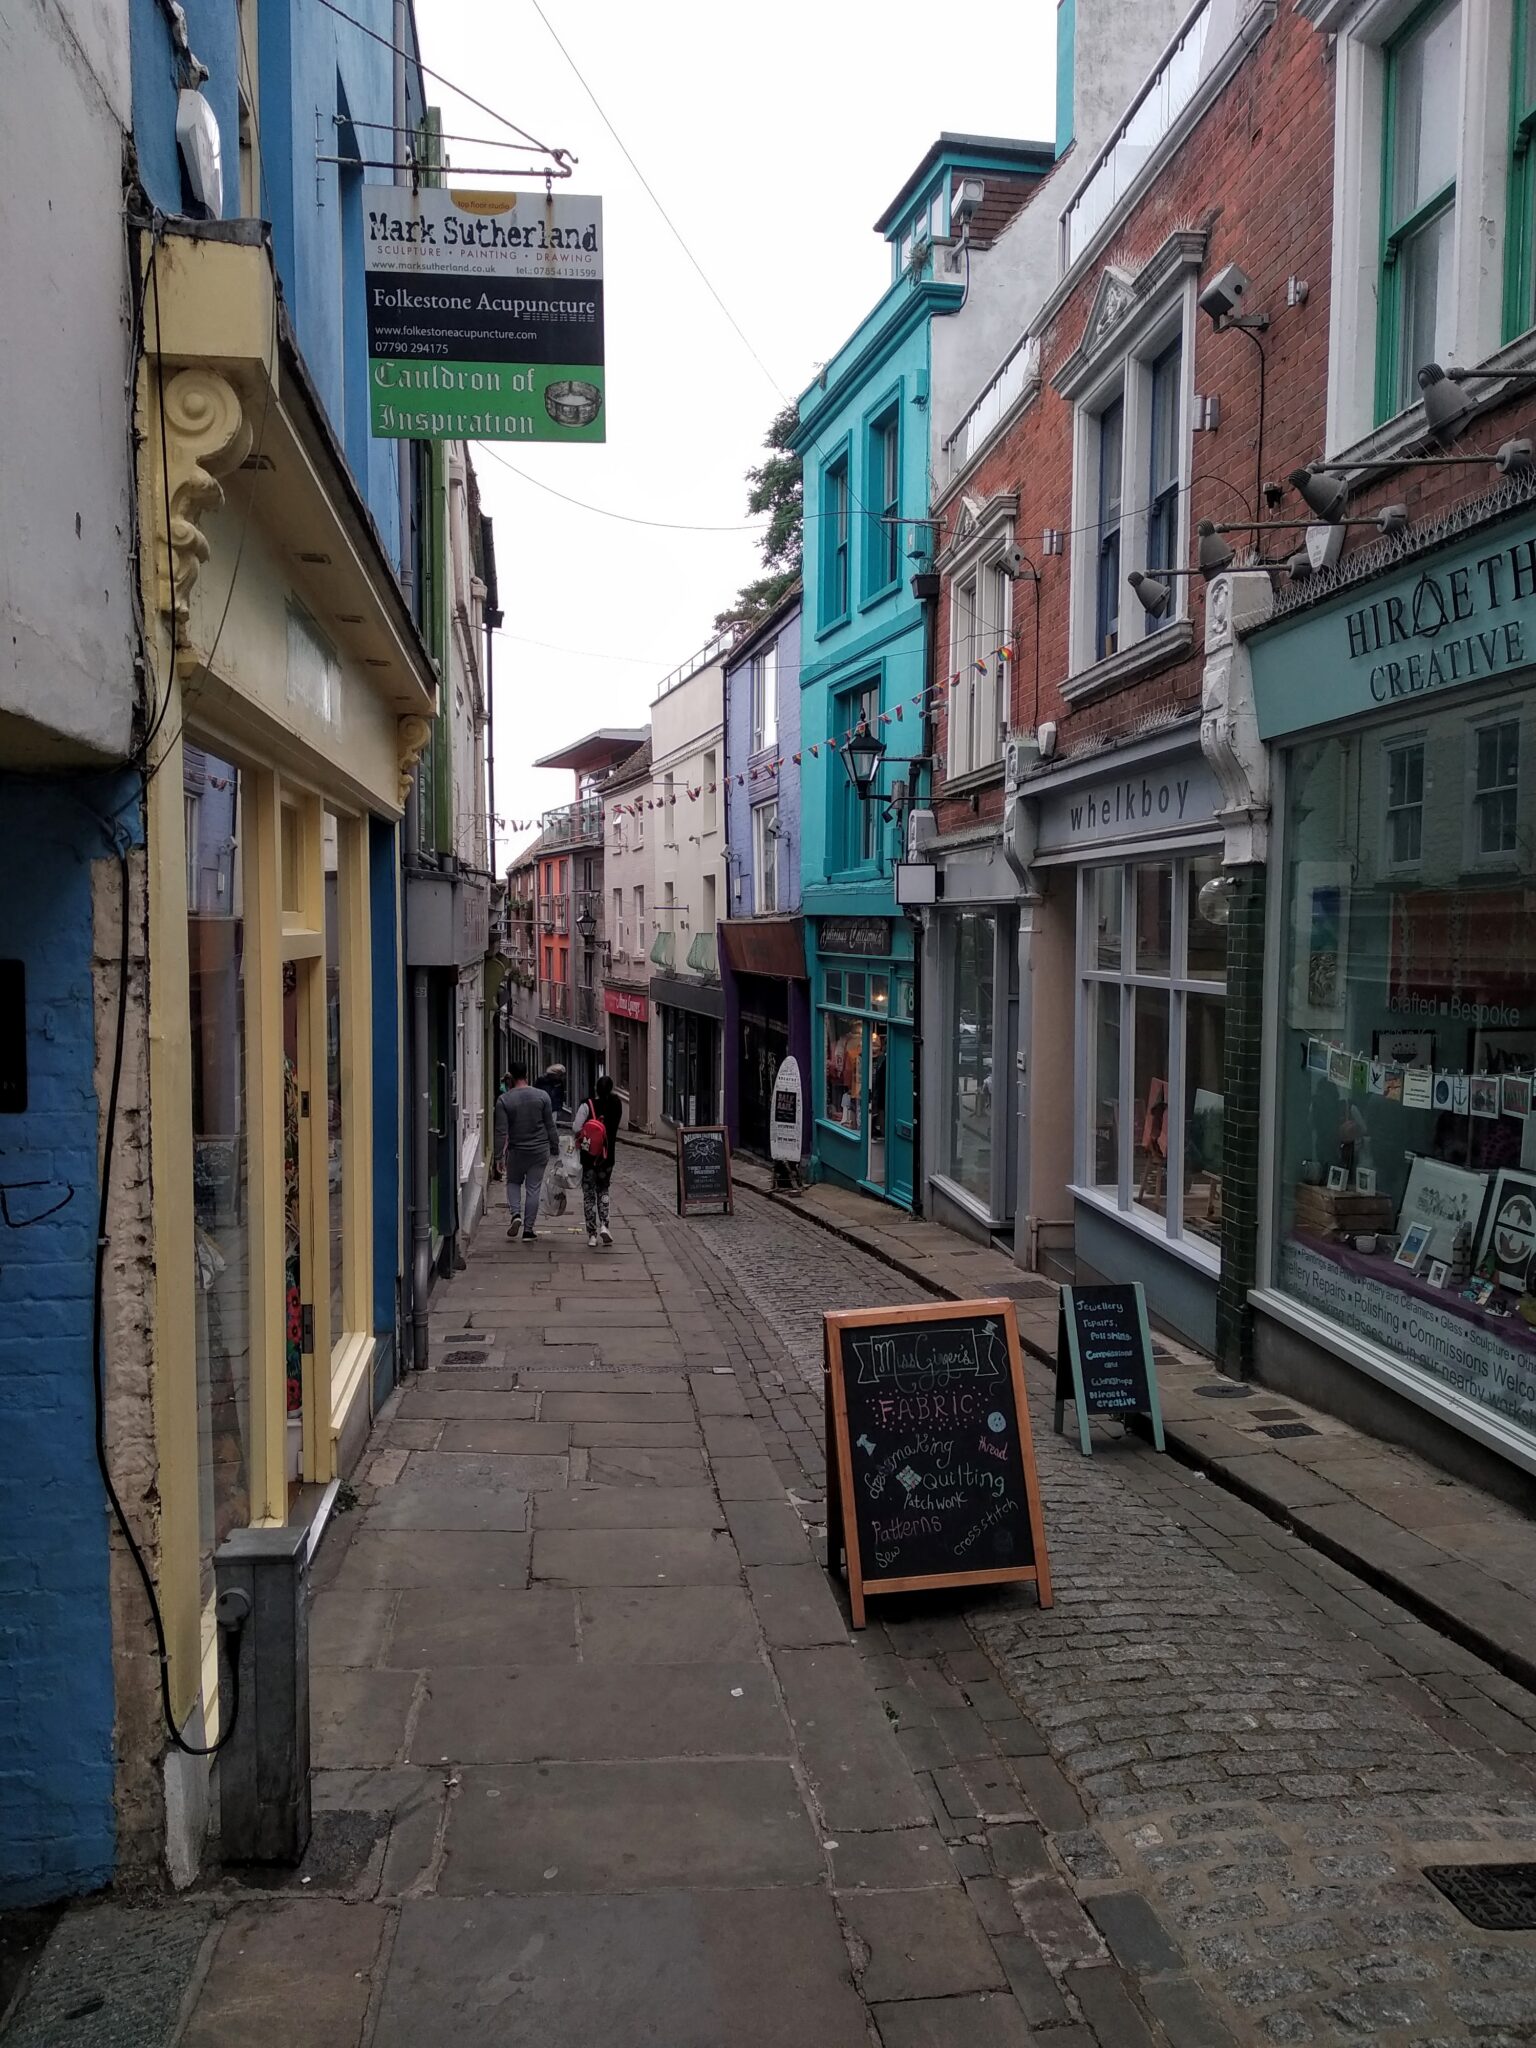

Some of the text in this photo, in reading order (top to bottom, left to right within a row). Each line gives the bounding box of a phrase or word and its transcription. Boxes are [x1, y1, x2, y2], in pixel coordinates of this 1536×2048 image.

[369, 212, 598, 252] Mark Sutherland
[372, 261, 496, 273] www.marksutherland.co.uk
[377, 245, 592, 263] SCULPTURE PAINTING DRAWING
[373, 288, 596, 317] Folkestone Acupuncture
[375, 325, 537, 340] www.folkestoneacupuncture.com
[375, 341, 449, 354] 07790 294175
[374, 362, 536, 392] Cauldron of
[378, 404, 535, 435] Inspiration
[1370, 620, 1525, 702] CREATIVE
[1070, 780, 1189, 832] whelkboy
[1451, 995, 1520, 1027] Bespoke
[1076, 1300, 1124, 1313] Jewellery
[1327, 1264, 1339, 1276] and
[1362, 1277, 1385, 1299] Pottery
[1386, 1292, 1399, 1305] and
[1400, 1291, 1435, 1322] Ceramics
[1440, 1315, 1463, 1337] Glass
[1469, 1330, 1510, 1361] Sculpture
[1312, 1270, 1346, 1302] Repairs
[1354, 1291, 1399, 1334] Polishing
[1408, 1319, 1489, 1377] Commissions
[1492, 1361, 1536, 1402] Welco
[875, 1340, 917, 1393] Miss
[1442, 1365, 1485, 1400] nearby
[879, 1394, 973, 1422] FABRIC
[923, 1462, 1005, 1497] Quilting
[871, 1516, 942, 1544] Patterns
[875, 1545, 900, 1568] Sew
